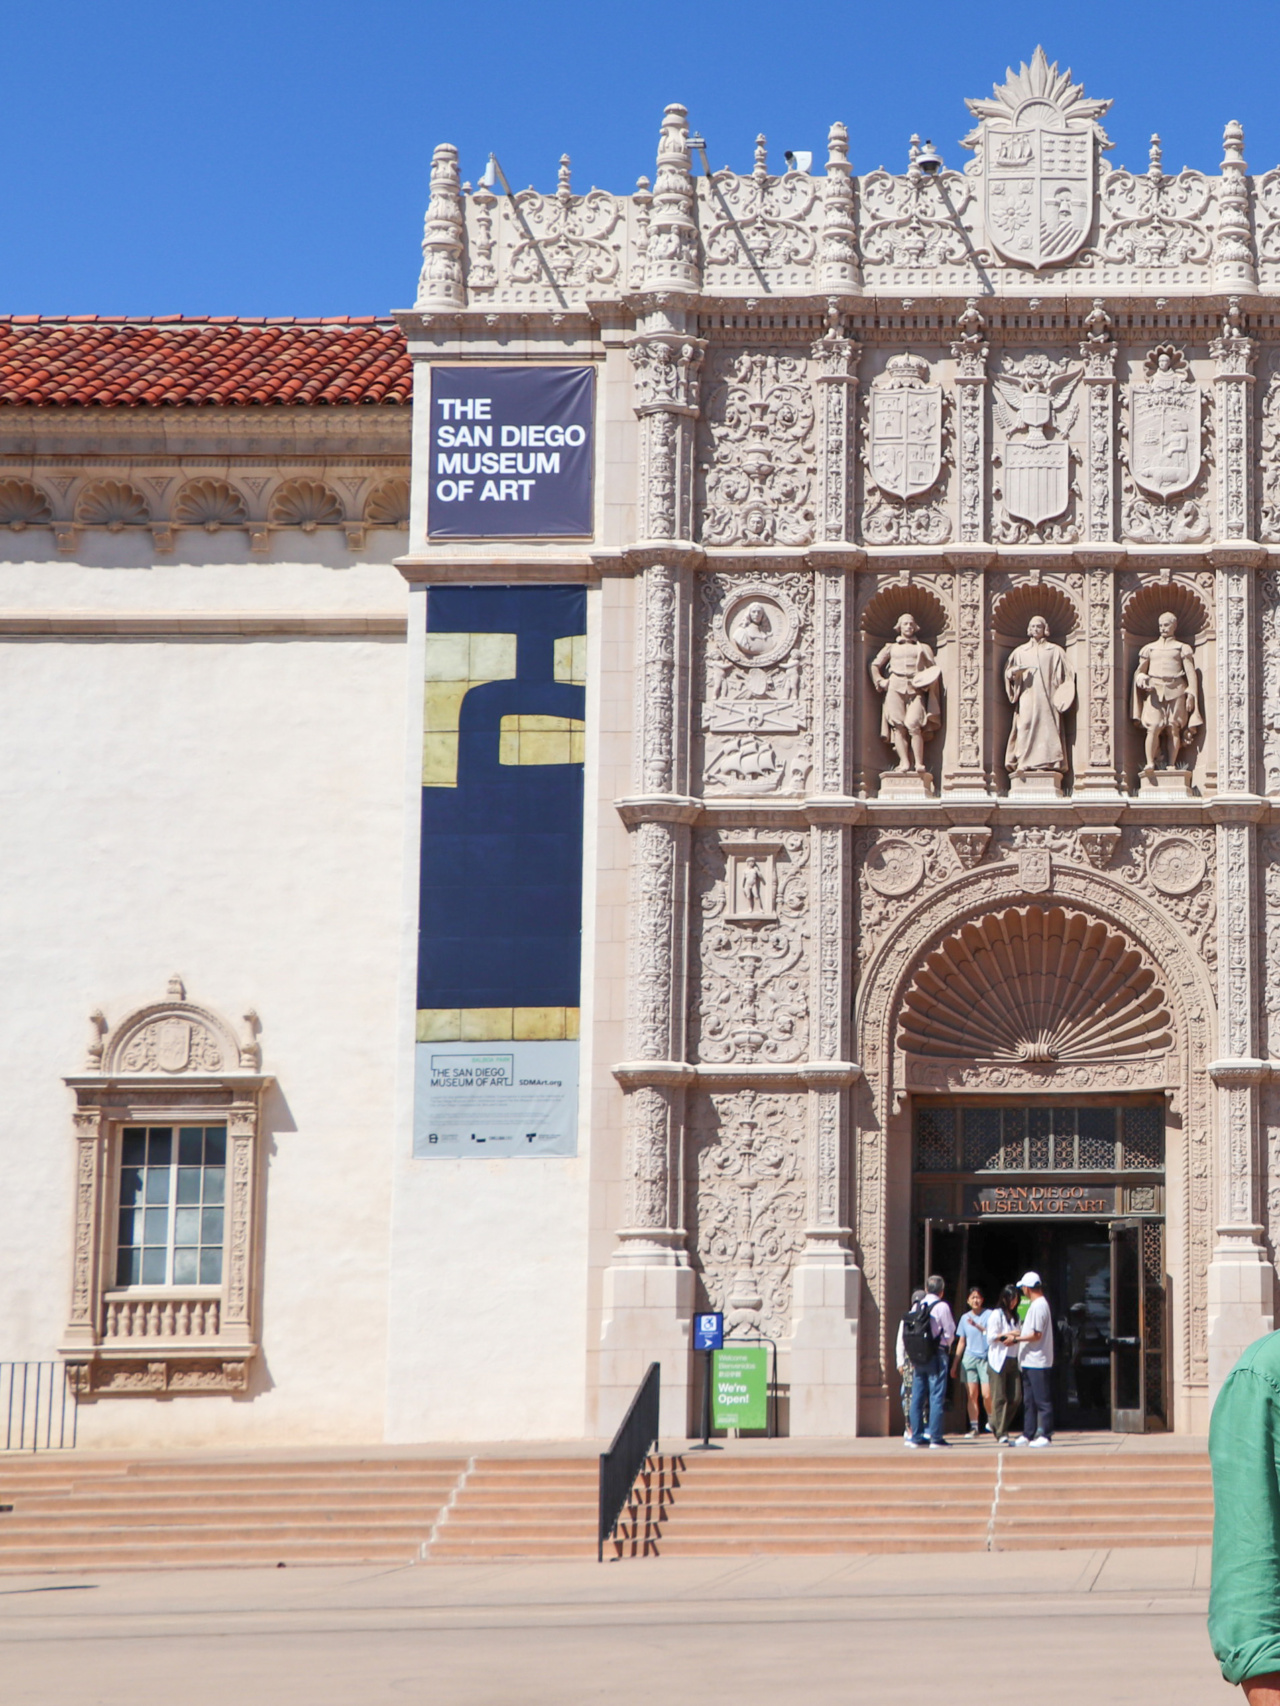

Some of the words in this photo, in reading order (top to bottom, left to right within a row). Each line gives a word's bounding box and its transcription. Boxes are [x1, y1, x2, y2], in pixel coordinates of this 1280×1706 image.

[437, 398, 492, 420] THE
[437, 425, 493, 447] SAN
[501, 424, 586, 447] DIEGO
[437, 452, 560, 475] MUSEUM
[436, 480, 475, 502] OF
[479, 479, 536, 501] ART
[432, 1068, 451, 1078] THE
[452, 1068, 473, 1077] SAN
[475, 1067, 506, 1077] DIEGO
[430, 1078, 474, 1087] MUSEUM
[475, 1078, 490, 1087] OF
[490, 1077, 509, 1087] ART
[519, 1079, 563, 1087] SDMArt.org
[995, 1186, 1029, 1199] SAN
[1032, 1186, 1085, 1199] DIEGO
[972, 1199, 1044, 1214] MUSEUM
[1047, 1199, 1072, 1213] OF
[1073, 1199, 1107, 1213] ART
[718, 1383, 747, 1392] We're
[718, 1394, 749, 1405] Open!
